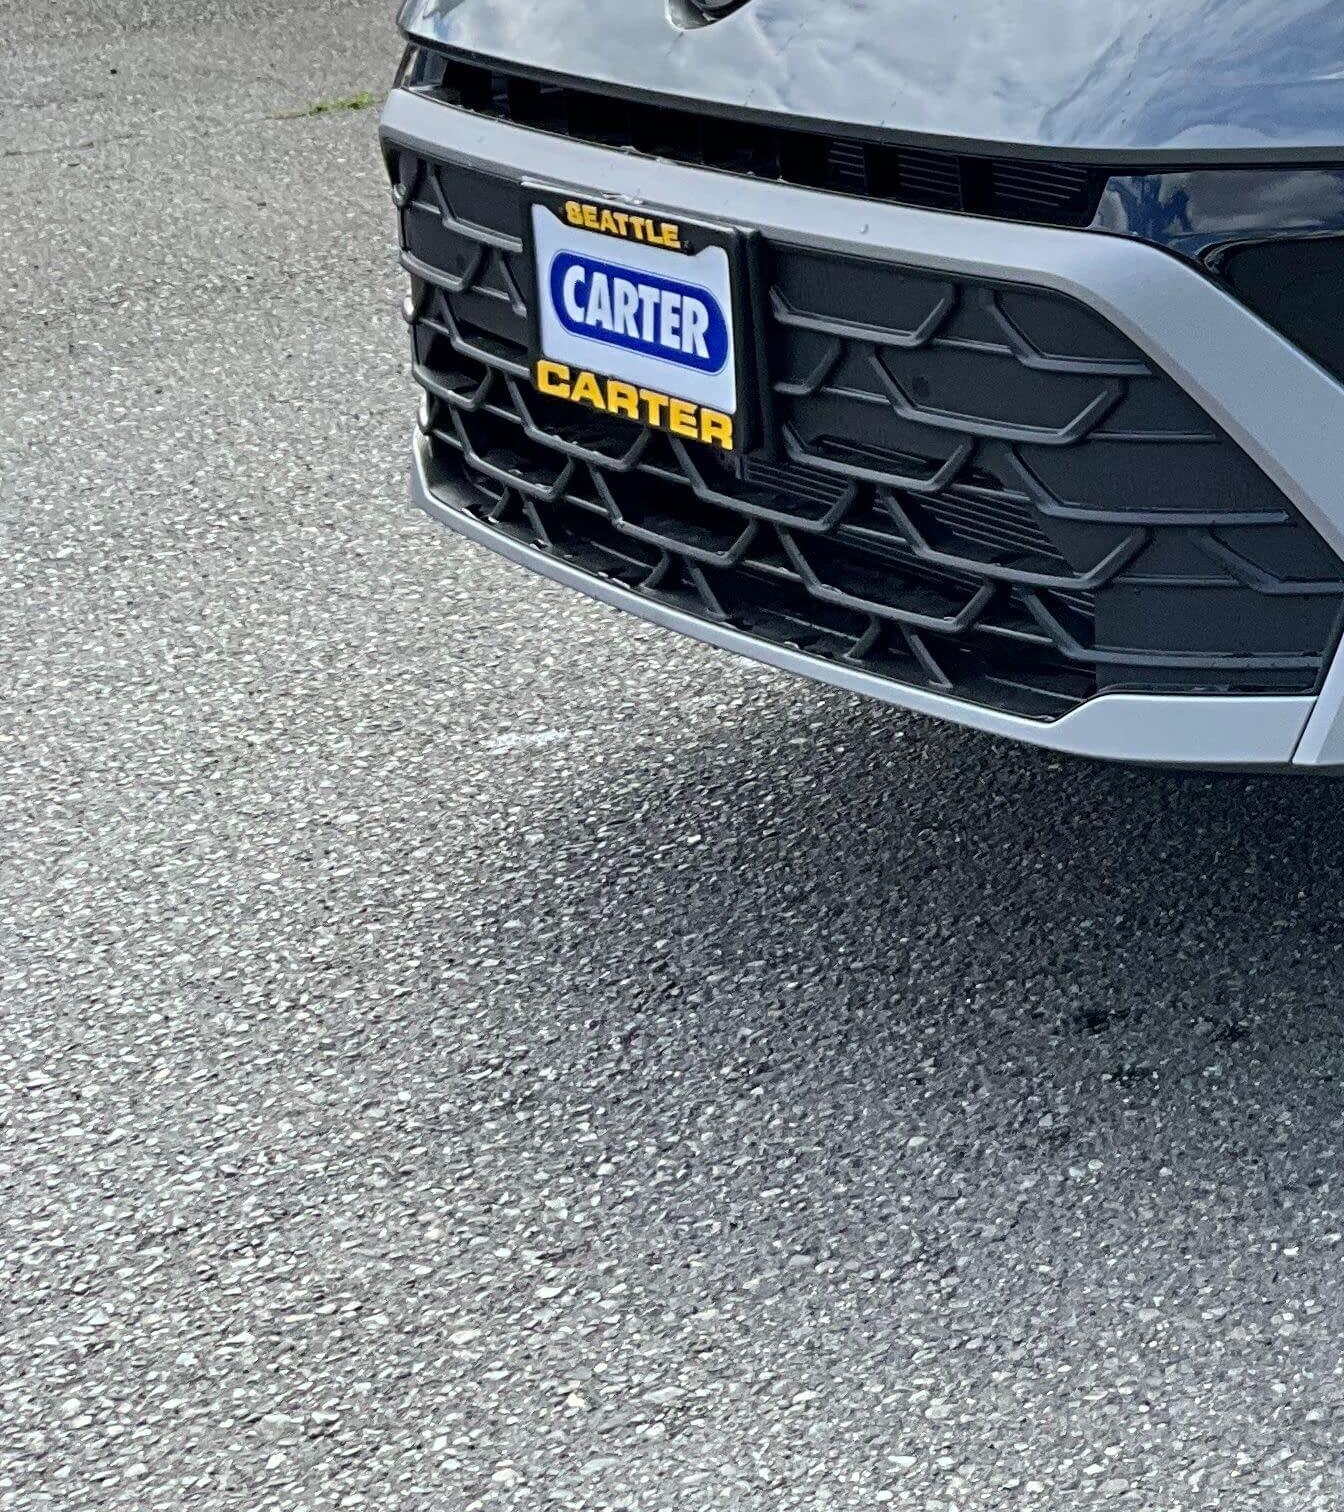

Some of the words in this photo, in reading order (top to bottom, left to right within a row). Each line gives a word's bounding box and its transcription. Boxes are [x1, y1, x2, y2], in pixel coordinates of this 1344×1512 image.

[565, 201, 681, 248] SEATTLE
[563, 264, 710, 359] CARTER
[537, 359, 734, 450] CARTER
